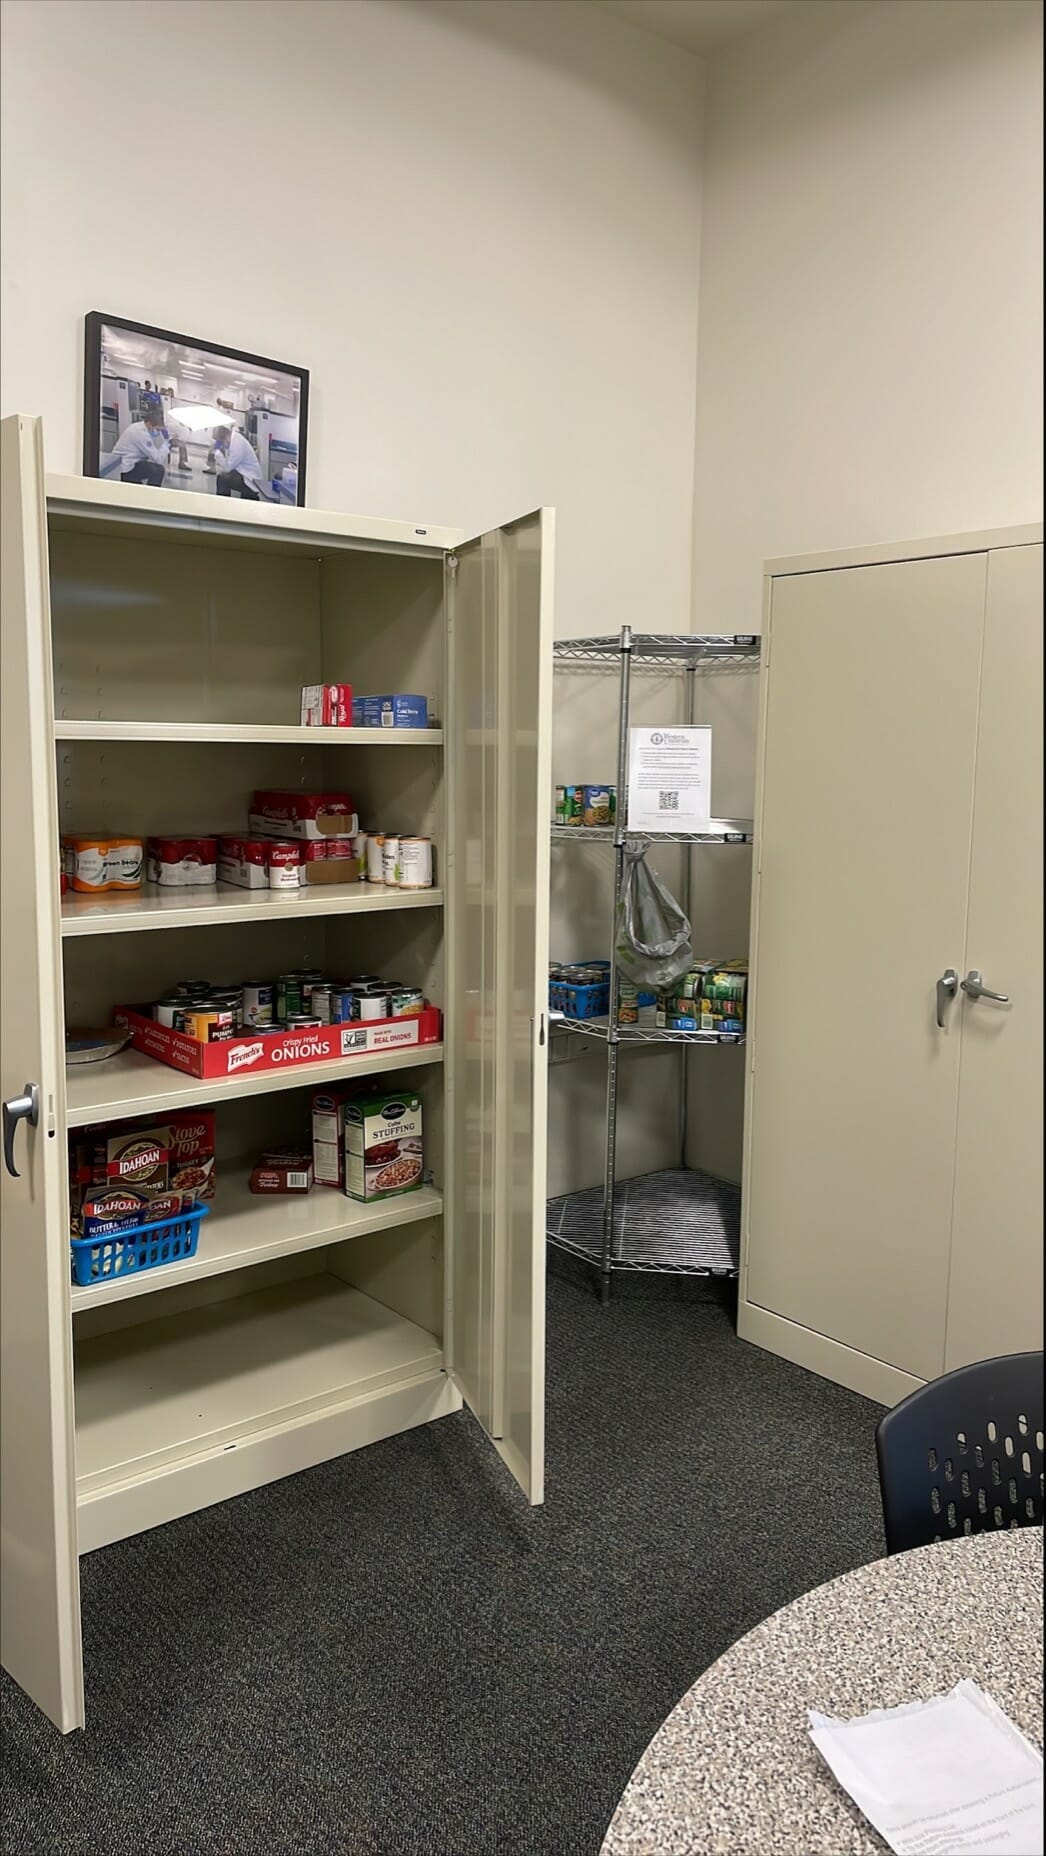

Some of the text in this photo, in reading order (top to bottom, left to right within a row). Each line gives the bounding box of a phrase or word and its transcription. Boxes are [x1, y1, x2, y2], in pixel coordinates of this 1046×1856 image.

[282, 1034, 319, 1047] Crispy Fried
[374, 1036, 389, 1045] REAL
[390, 1032, 412, 1042] ONIONS
[230, 1046, 260, 1066] French's
[271, 1041, 330, 1062] ONIONS
[168, 1124, 207, 1150] Stove
[372, 1122, 415, 1140] STUFFING
[175, 1139, 200, 1158] Top
[119, 1149, 160, 1175] IDAHOAN
[93, 1199, 141, 1216] IDAHOAN
